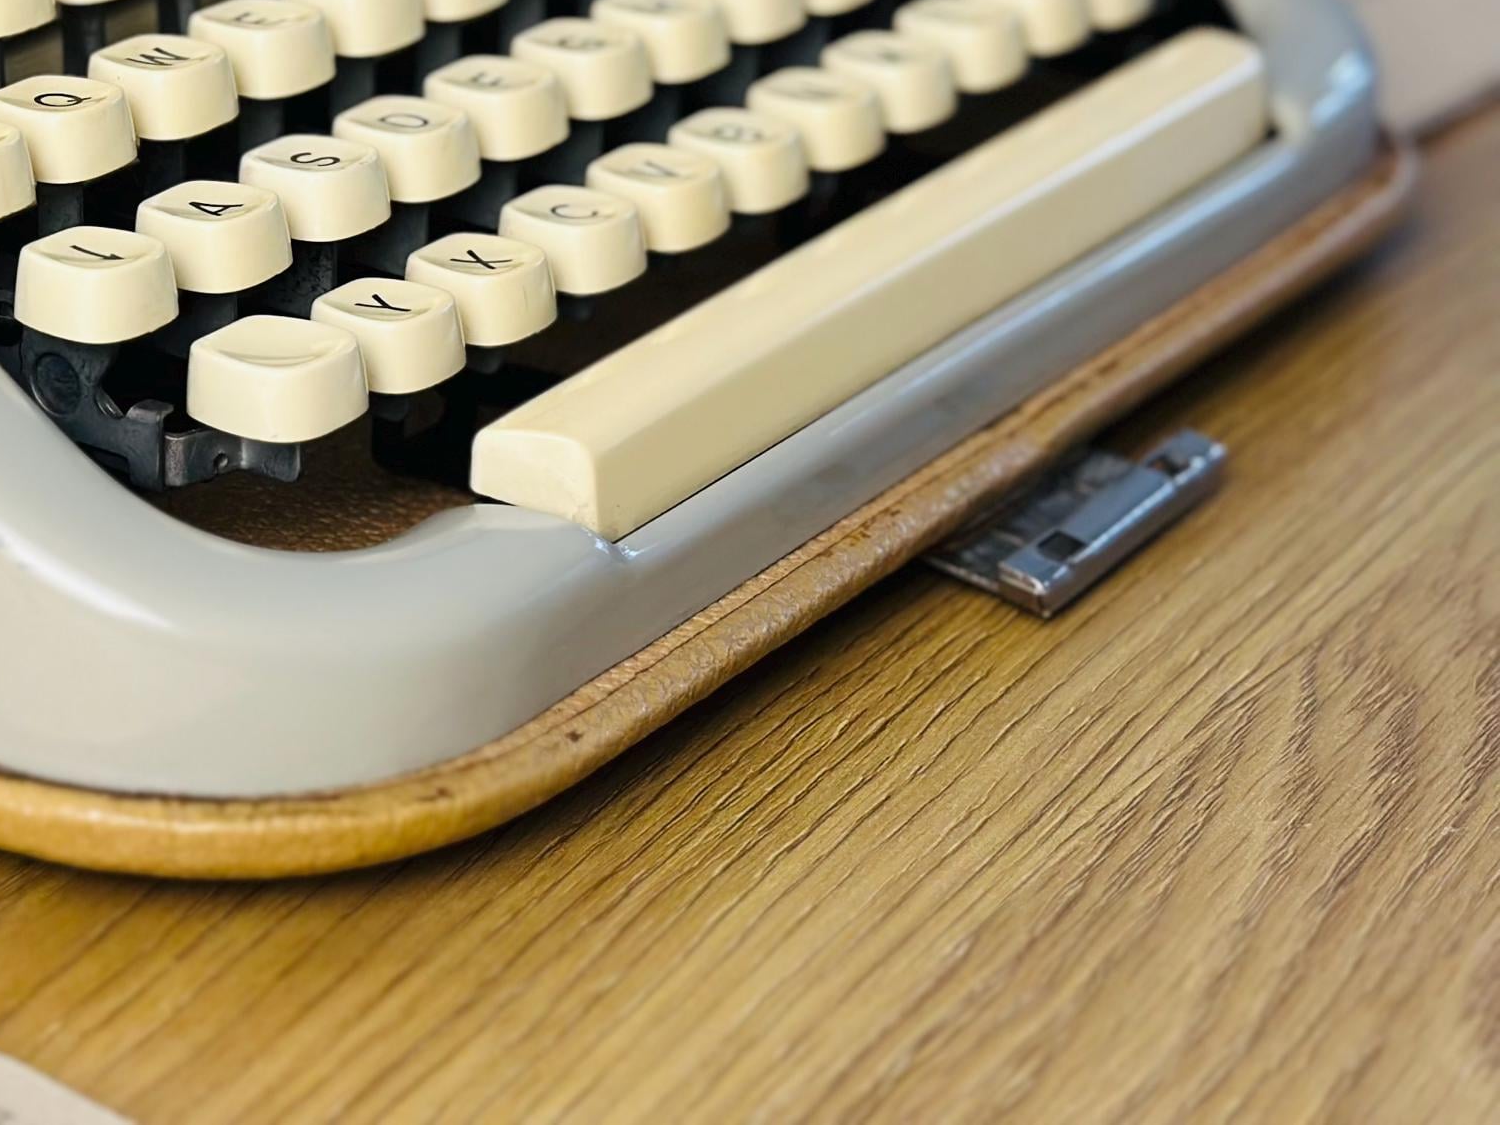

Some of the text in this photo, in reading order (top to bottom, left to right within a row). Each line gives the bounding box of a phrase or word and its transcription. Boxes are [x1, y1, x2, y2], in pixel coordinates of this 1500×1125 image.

[124, 47, 191, 67] W
[34, 92, 92, 108] Q
[289, 151, 341, 169] S
[188, 198, 244, 217] A
[550, 204, 599, 221] C
[449, 249, 514, 270] X
[354, 293, 412, 313] Y
